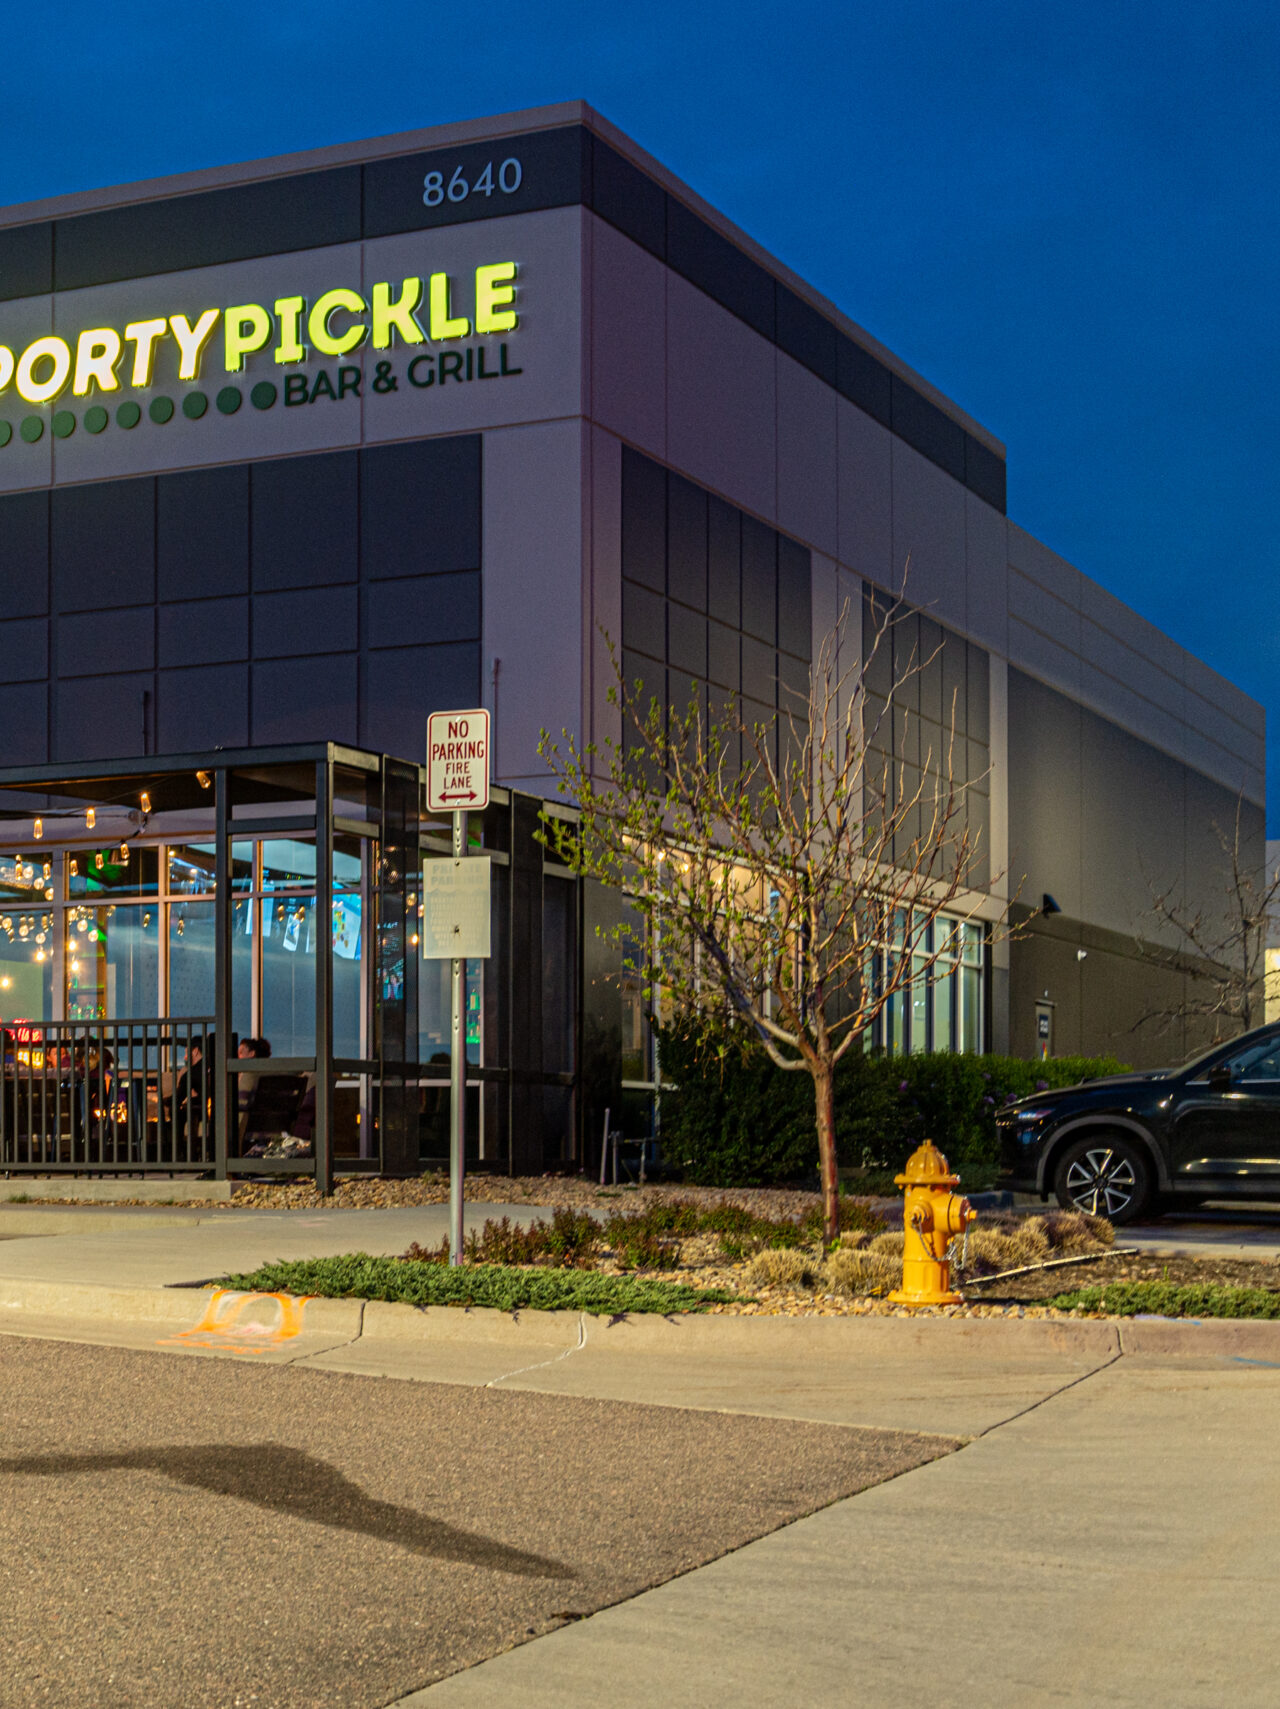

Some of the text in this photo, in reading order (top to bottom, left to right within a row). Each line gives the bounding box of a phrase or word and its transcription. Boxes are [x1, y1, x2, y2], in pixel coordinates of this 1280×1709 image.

[422, 157, 523, 207] 8640
[284, 344, 523, 407] BAR & GRILL
[448, 720, 469, 739] NO
[432, 740, 485, 761] PARKING
[445, 761, 470, 775] FIRE
[443, 775, 472, 790] LANE
[432, 863, 482, 874] PRITE
